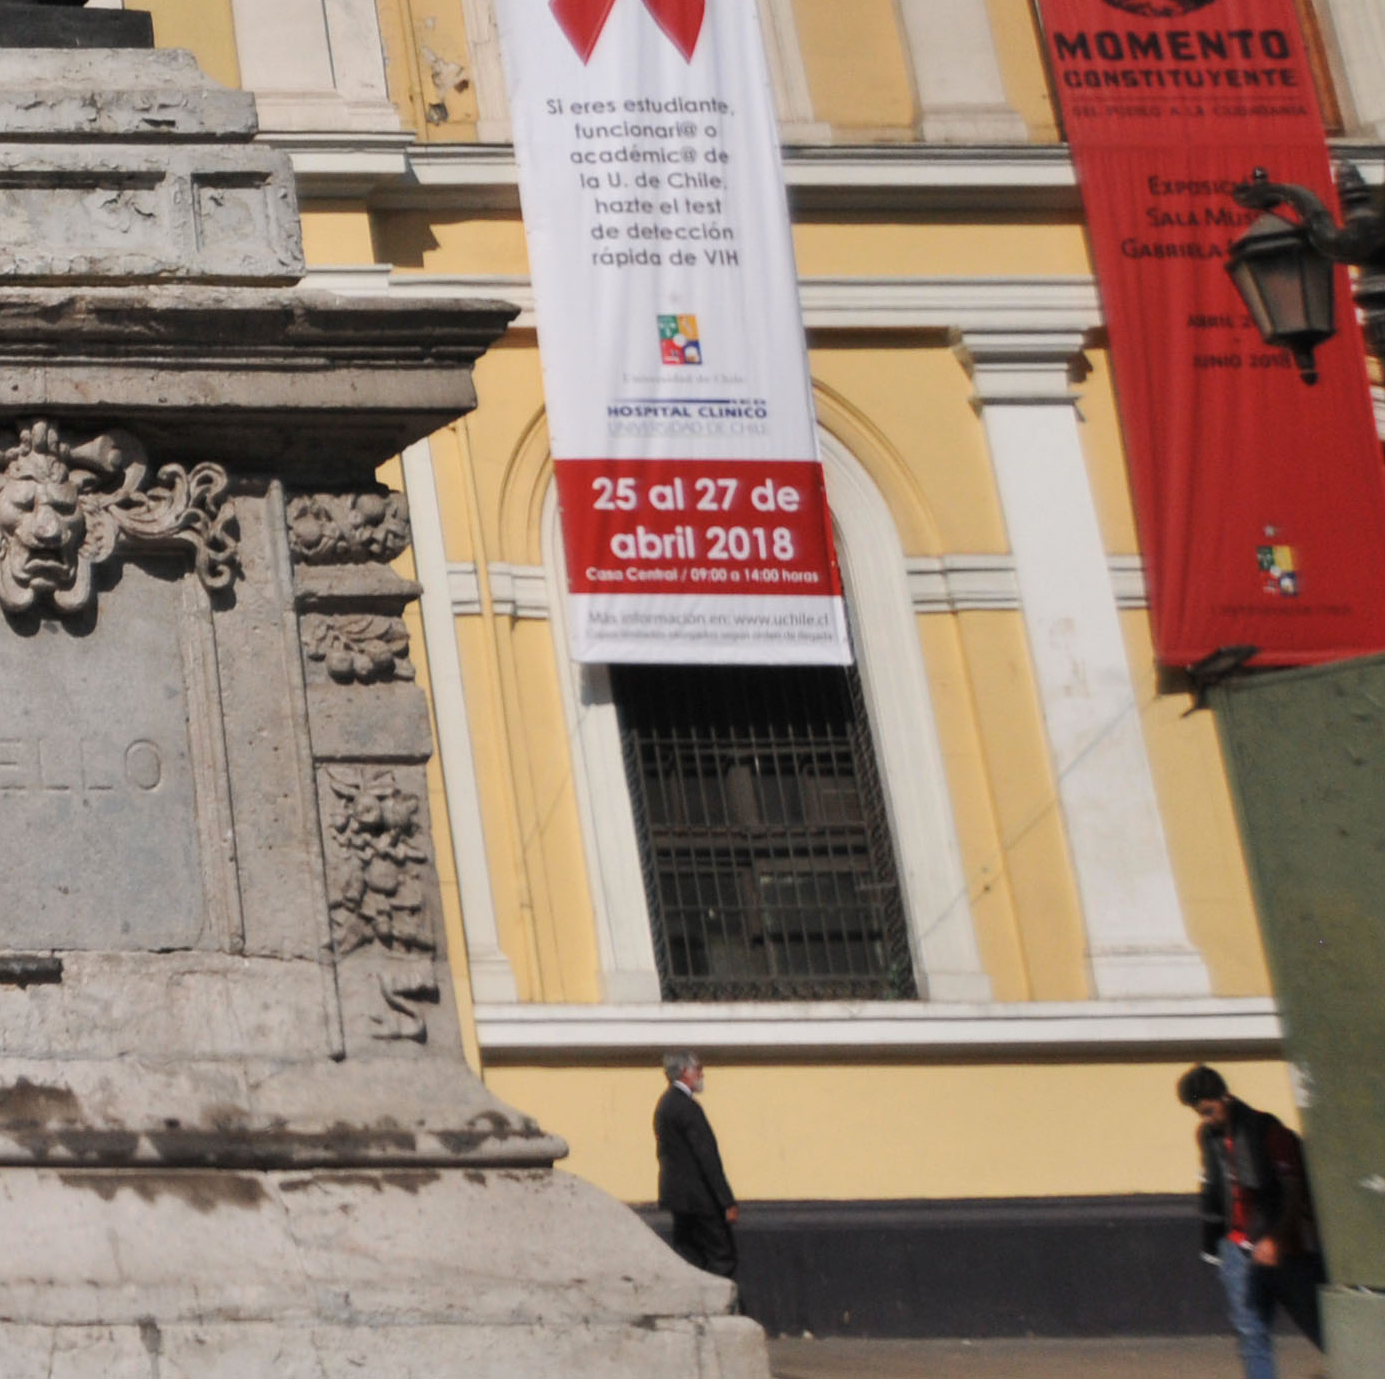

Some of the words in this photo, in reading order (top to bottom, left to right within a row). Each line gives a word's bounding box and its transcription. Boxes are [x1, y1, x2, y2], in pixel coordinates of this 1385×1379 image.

[1053, 29, 1291, 62] MOMENTO
[1063, 69, 1299, 89] CONSTITUYENTE
[546, 98, 563, 115] Si
[569, 100, 616, 115] eres
[623, 96, 736, 117] estudiante,
[574, 121, 697, 139] funcionari@
[704, 125, 717, 138] o
[569, 143, 697, 164] académic@
[704, 147, 729, 164] de
[580, 173, 600, 190] la
[608, 173, 628, 189] U.
[635, 173, 660, 189] de
[667, 173, 728, 191] Chile,
[595, 198, 654, 215] hazte
[659, 197, 679, 215] el
[685, 198, 722, 214] test
[591, 223, 620, 240] de
[626, 221, 734, 240] detección
[592, 246, 662, 268] rápida
[669, 249, 697, 266] de
[703, 249, 739, 266] VIH
[607, 406, 692, 419] HOSPITAL
[698, 406, 768, 419] CLINICO
[591, 477, 637, 511] 25
[649, 477, 684, 511] al
[695, 478, 738, 511] 27
[751, 478, 800, 512] de
[610, 526, 695, 560] abril
[706, 526, 795, 561] 2018
[586, 567, 623, 582] Casa
[626, 567, 678, 582] Central
[690, 568, 728, 582] 09:00
[745, 568, 780, 582] 14:00
[782, 569, 819, 583] horas
